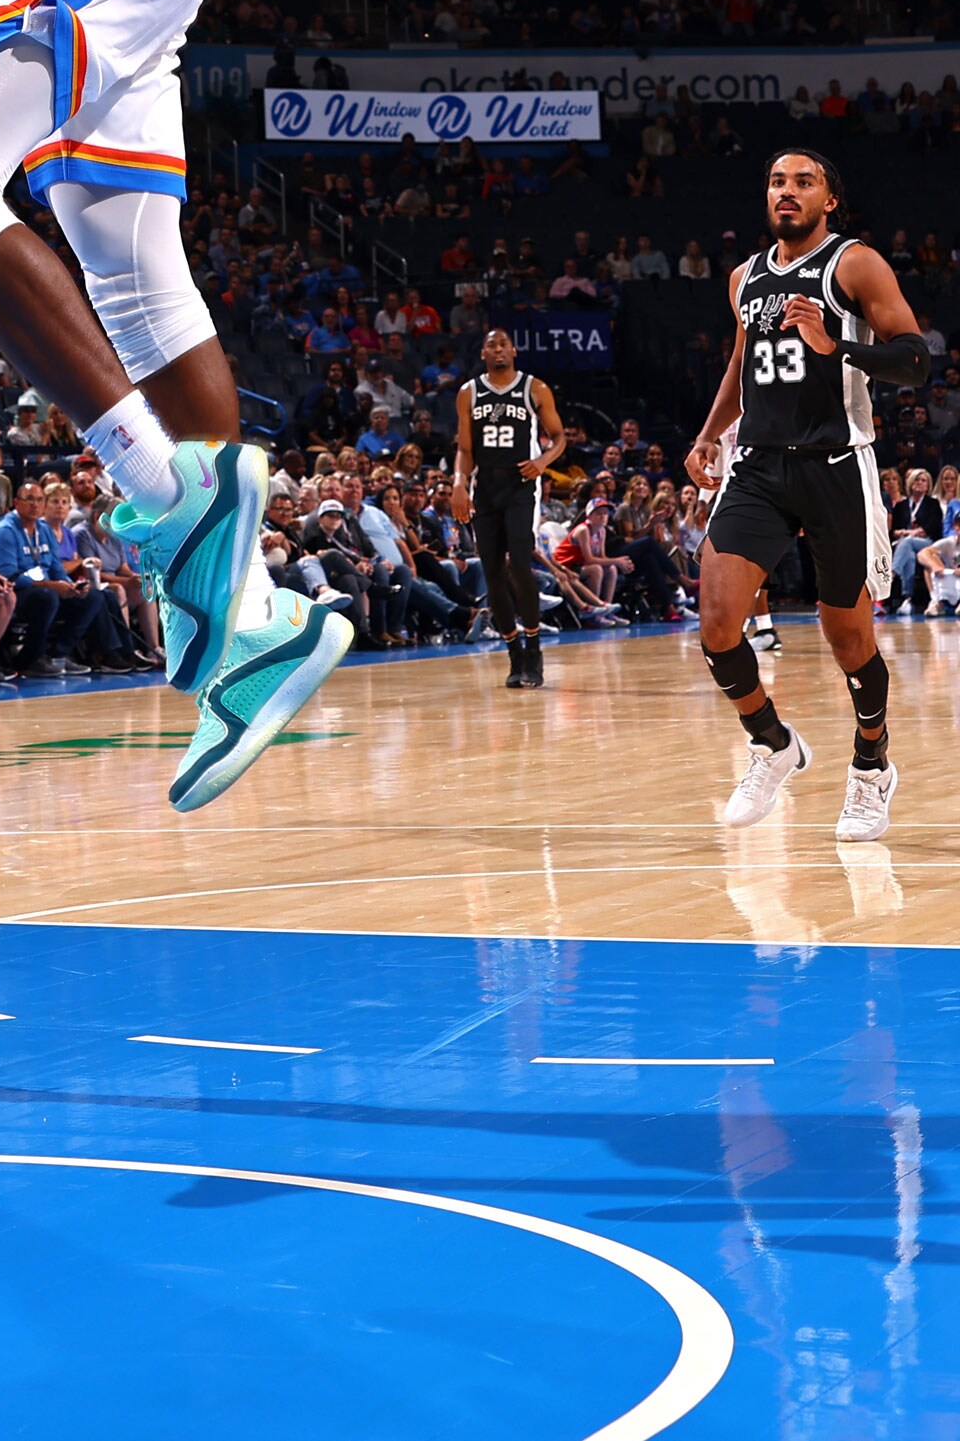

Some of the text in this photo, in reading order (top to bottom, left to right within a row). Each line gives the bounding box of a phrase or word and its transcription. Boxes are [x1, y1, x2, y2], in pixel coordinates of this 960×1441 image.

[193, 61, 242, 98] 109
[512, 328, 604, 352] ULTRA
[754, 337, 806, 385] 33
[482, 425, 515, 448] 22
